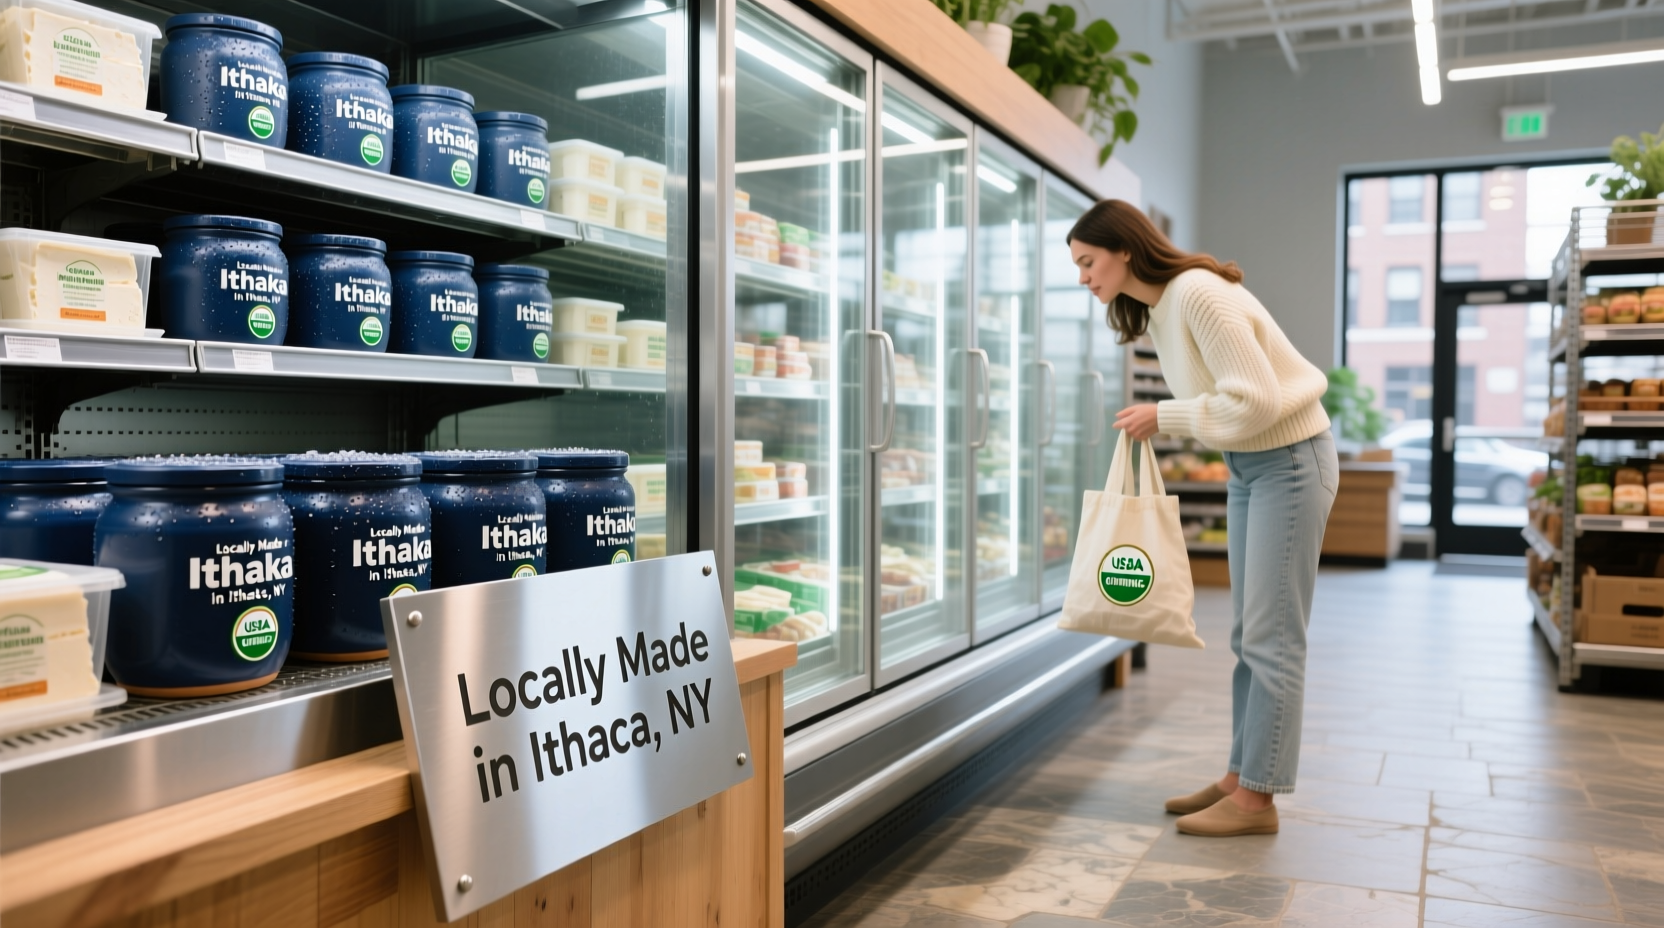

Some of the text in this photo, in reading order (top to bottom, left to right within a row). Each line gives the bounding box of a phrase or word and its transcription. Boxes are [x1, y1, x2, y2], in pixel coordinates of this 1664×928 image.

[221, 66, 287, 101] Ithaka
[220, 268, 288, 296] Ithaka
[335, 282, 391, 306] Ithaka
[216, 540, 256, 556] Locally
[481, 521, 548, 550] Ithaka
[352, 535, 433, 568] Ithaka
[189, 552, 294, 590] Ithaka
[273, 582, 287, 597] NY
[457, 621, 709, 727] Locally Made
[473, 677, 712, 803] in Ithaca, NY
